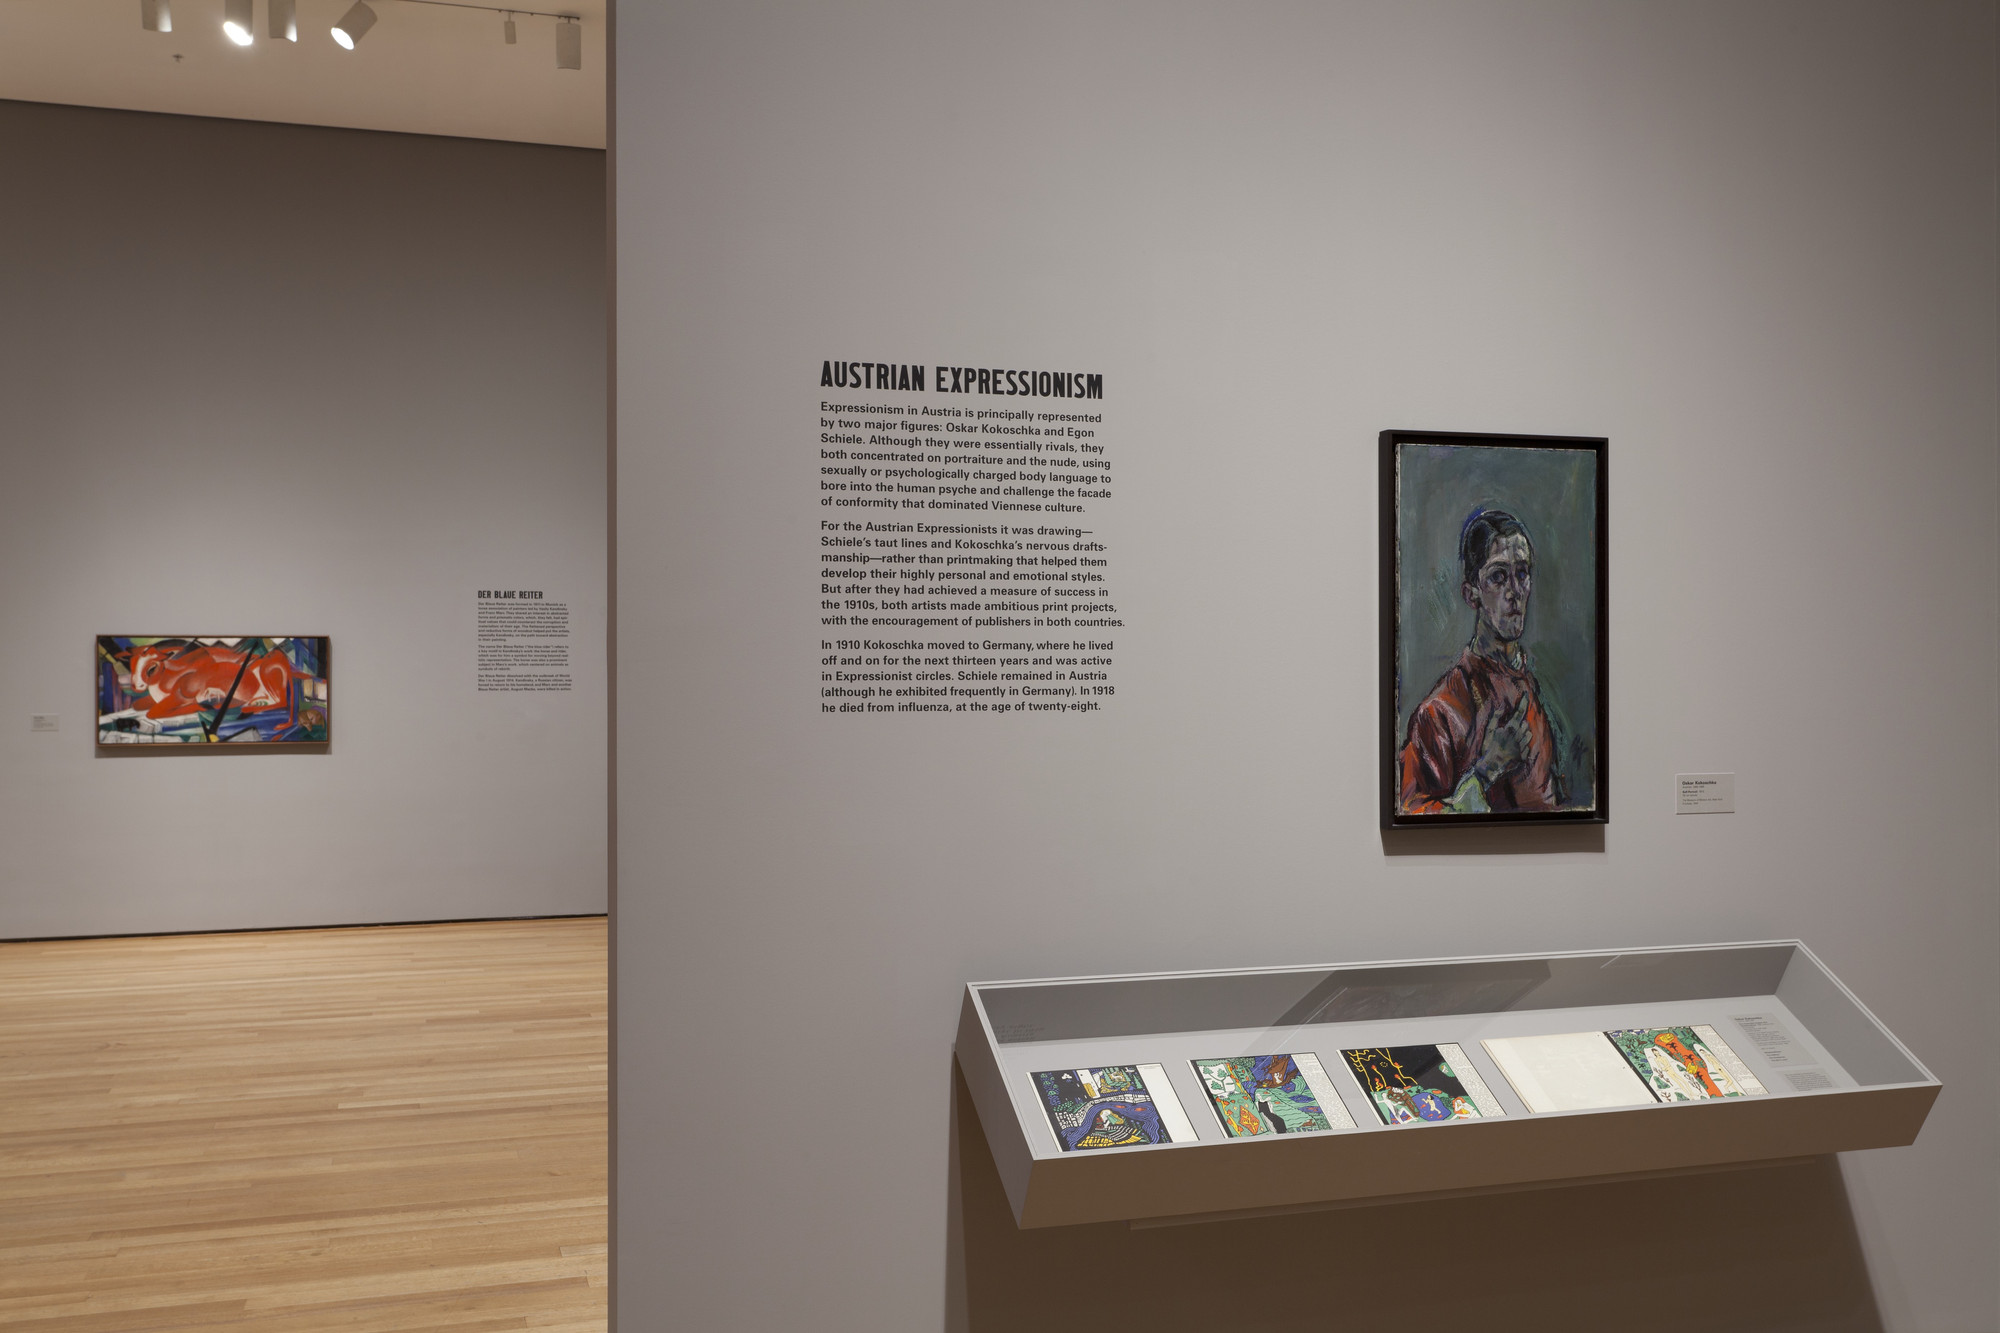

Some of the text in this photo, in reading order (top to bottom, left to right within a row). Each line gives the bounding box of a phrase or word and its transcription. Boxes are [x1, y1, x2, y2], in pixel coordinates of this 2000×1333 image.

[820, 360, 1103, 399] AUSTRIAN EXPRESSIONISM
[821, 401, 1102, 423] Expressionism in Austria is principally represented
[821, 416, 1094, 439] by two major figures: Oskar Kokoschka and Egon
[821, 432, 1104, 455] Schiele. Although they were essentially rivals, they
[821, 448, 1111, 470] both concentrated on portraiture and the nude, using
[821, 465, 1111, 485] sexually or psychologically charged body language to
[821, 480, 1112, 499] bore into the human psyche and challenge the facade
[821, 495, 1085, 513] of conformity that dominated Viennese culture.
[821, 520, 1093, 538] For the Austrian Expressionists it was drawing—
[821, 535, 1107, 552] Schiele's taut lines and Kokoschka's nervous drafts-
[821, 552, 1107, 568] manship—rather than printmaking that helped them
[821, 568, 1105, 583] develop their highly personal and emotional styles.
[478, 590, 543, 599] DER BLAUE REITER
[821, 583, 1108, 596] But after they had achieved a measure of success in
[821, 599, 1117, 614] the 1910s, both artists made ambitious print projects,
[821, 614, 1125, 628] with the encouragement of publishers in both countries.
[822, 639, 1113, 652] In 1910 Kokoschka moved to Germany, where he lived
[822, 654, 1112, 667] off and on for the next thirteen years and was active
[822, 670, 1107, 683] in Expressionist circles. Schiele remained in Austria
[821, 685, 1115, 699] (although he exhibited frequently in Germany). In 1918
[822, 700, 1101, 713] he died from influenza, at the age of twenty-eight.
